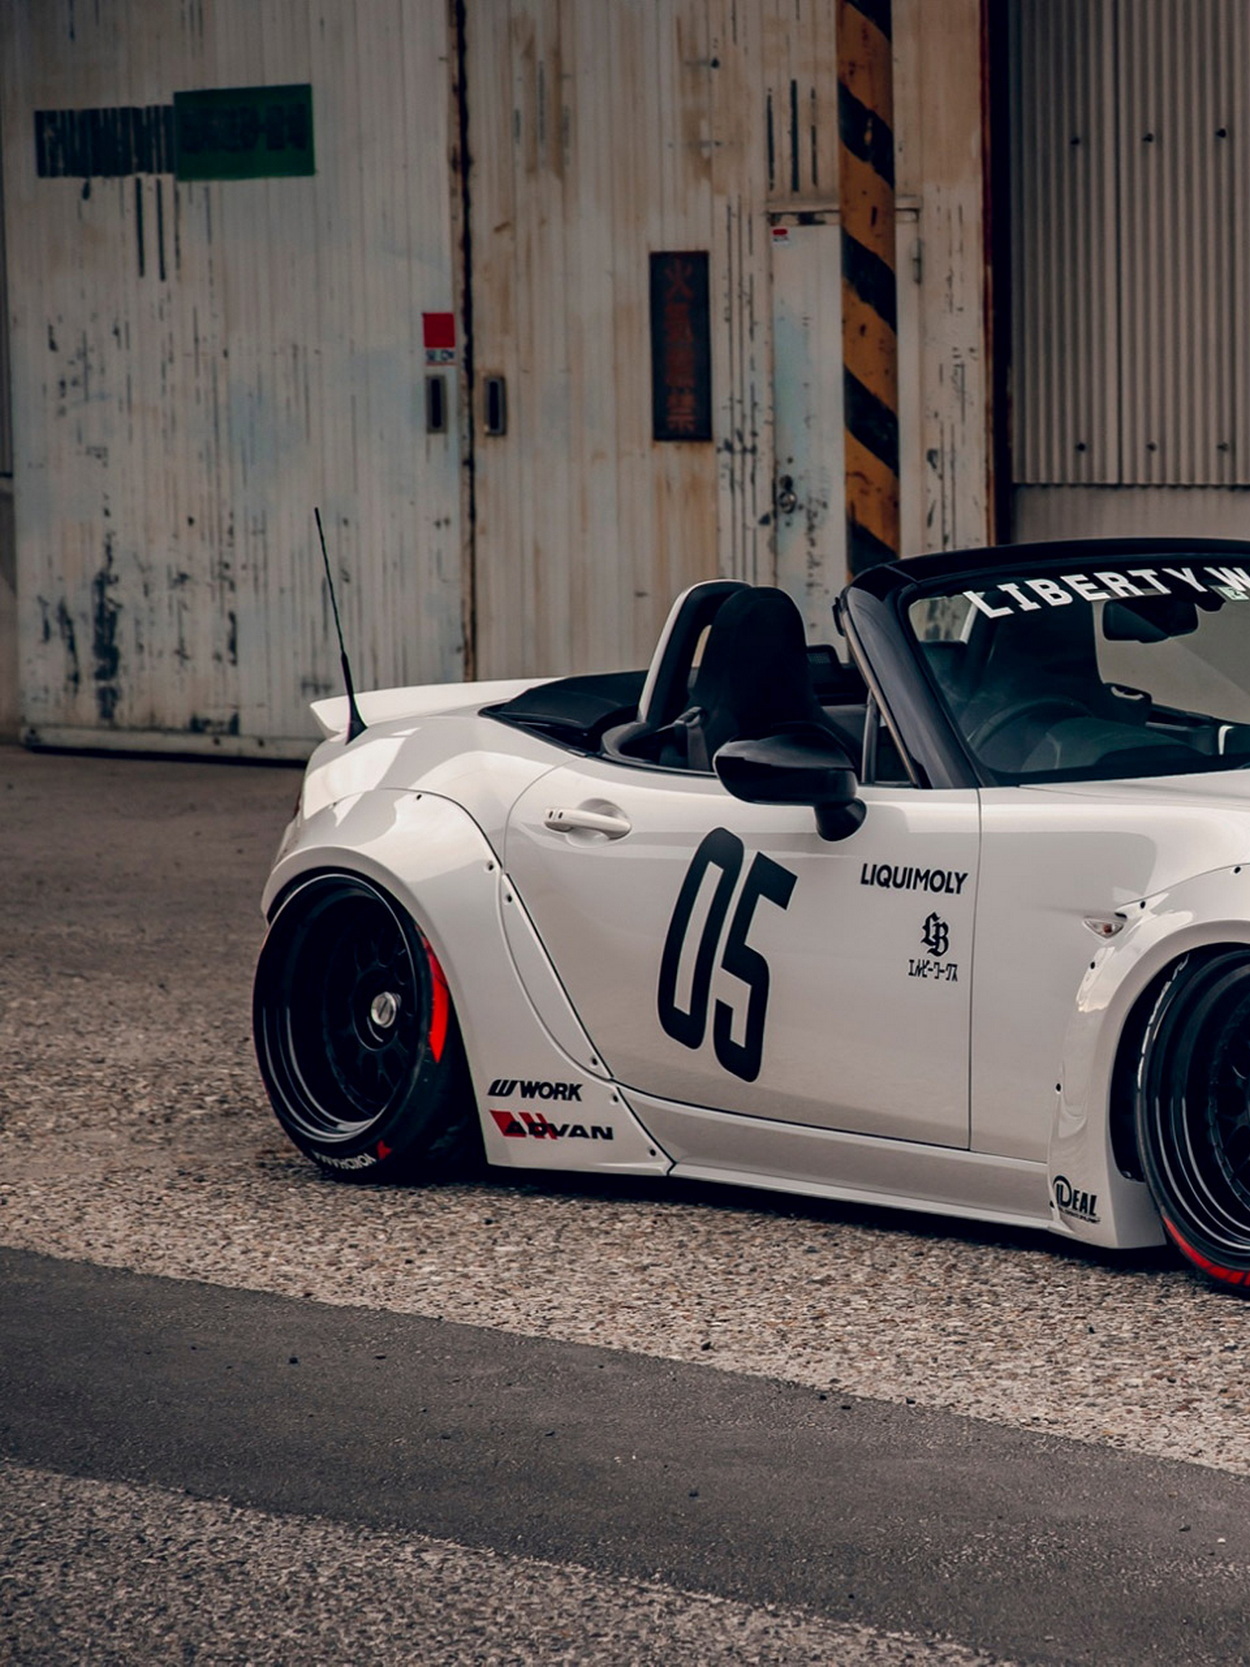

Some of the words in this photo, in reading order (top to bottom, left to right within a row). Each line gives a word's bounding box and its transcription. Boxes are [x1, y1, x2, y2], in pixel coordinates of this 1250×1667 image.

[963, 567, 1208, 619] LIBERTY
[658, 827, 798, 1083] 05
[519, 1080, 583, 1102] WORK
[505, 1121, 614, 1140] ADVAN
